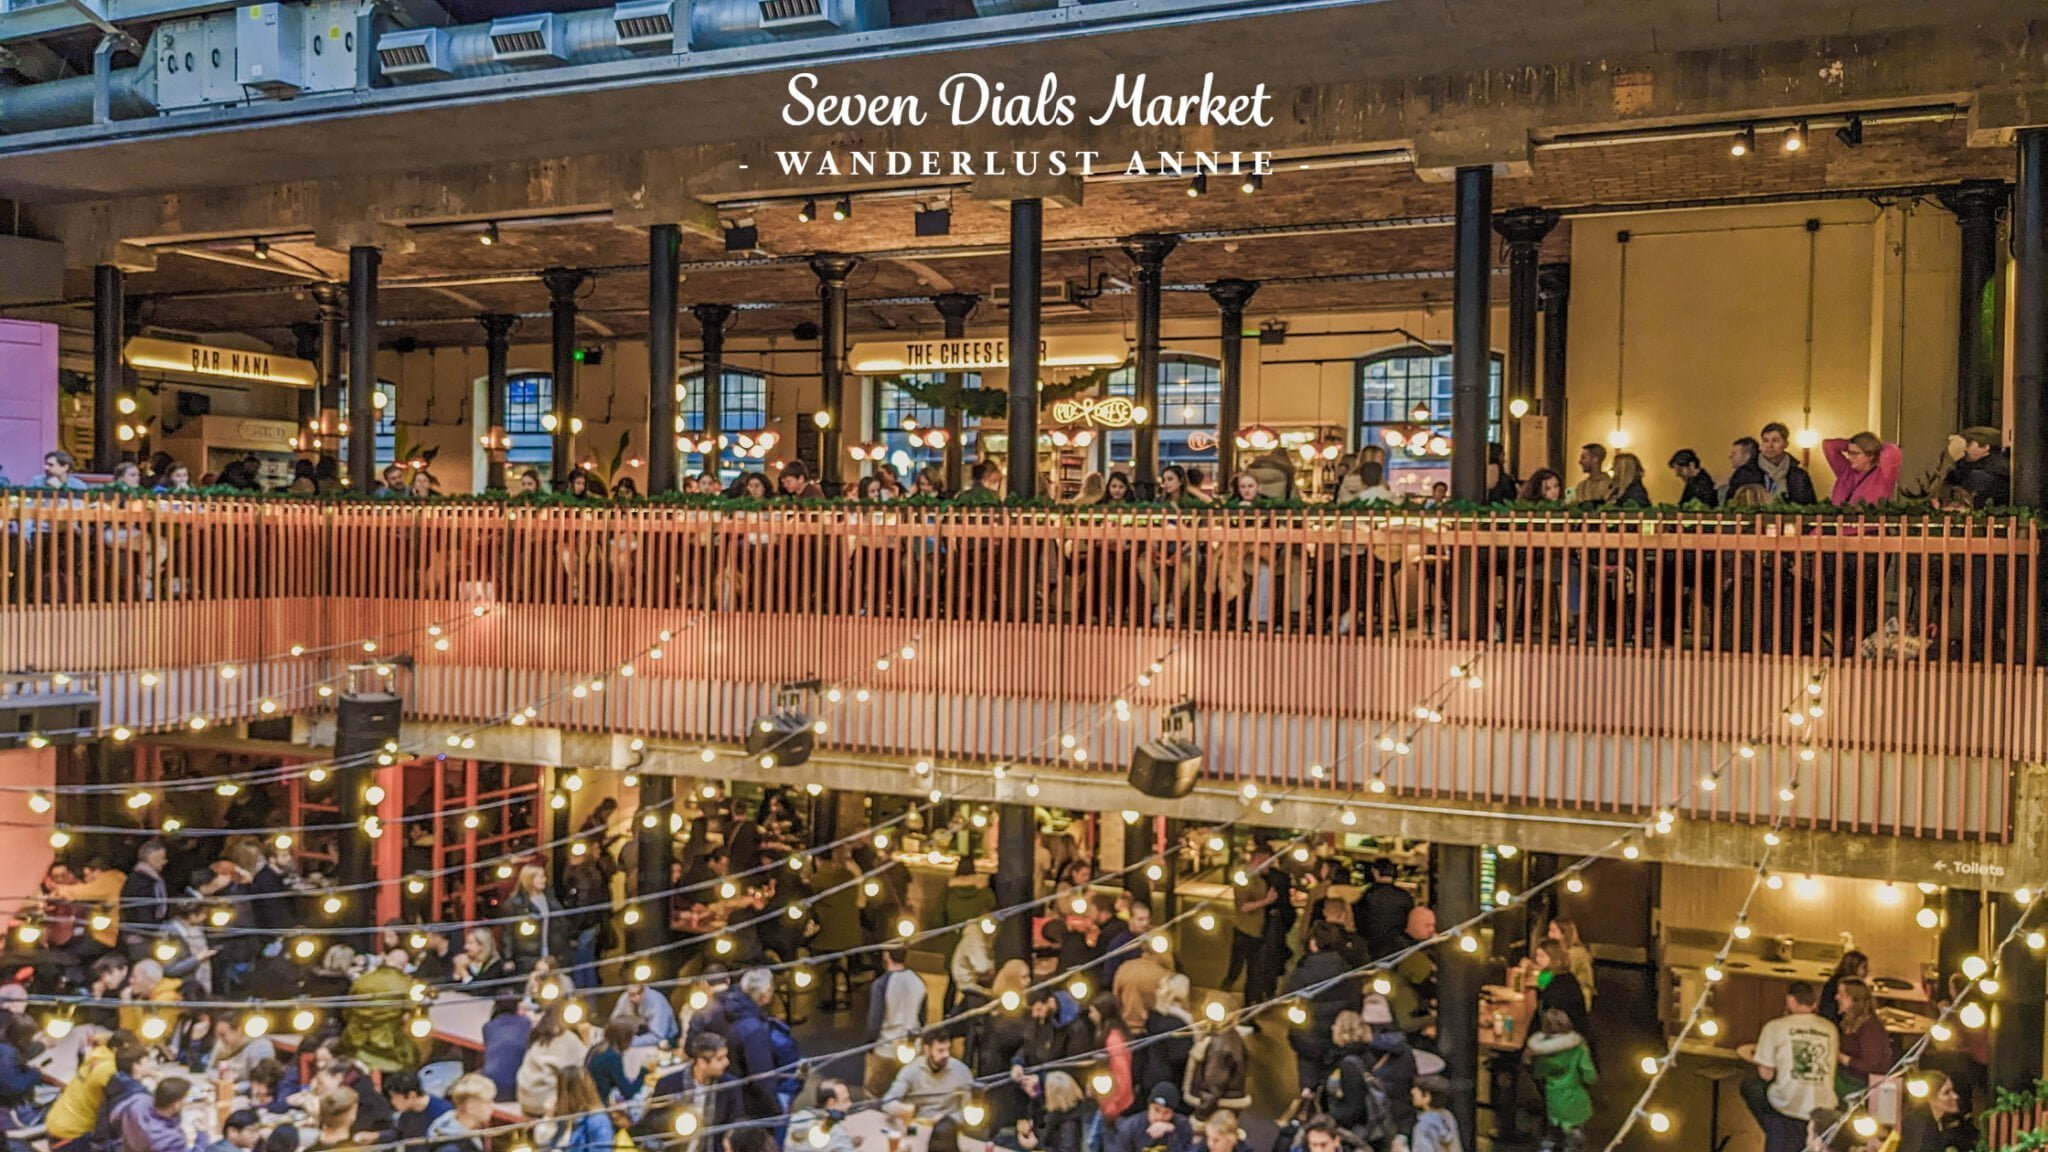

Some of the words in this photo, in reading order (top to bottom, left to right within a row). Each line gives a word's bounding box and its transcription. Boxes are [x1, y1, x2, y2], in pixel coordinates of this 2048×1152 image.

[192, 348, 220, 371] BAR
[232, 353, 269, 376] NANA
[907, 344, 933, 365] THE
[941, 341, 1004, 364] CHEESE
[1953, 861, 2005, 876] Toilets
